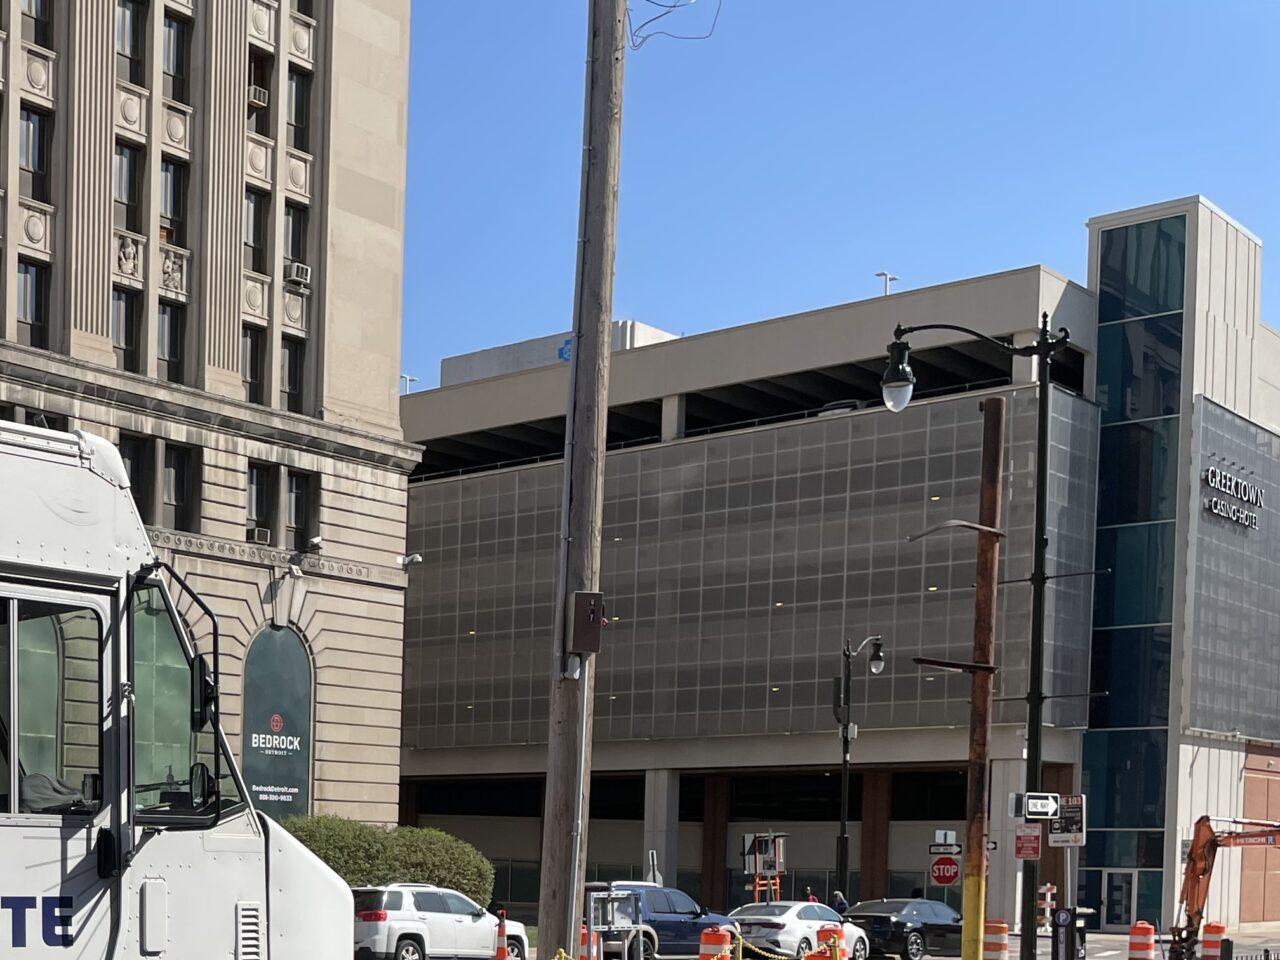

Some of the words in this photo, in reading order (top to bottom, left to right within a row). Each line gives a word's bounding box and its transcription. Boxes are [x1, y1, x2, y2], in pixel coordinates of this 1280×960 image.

[1208, 466, 1265, 507] GREEKTOWN
[252, 734, 300, 751] BEDROCK
[1029, 801, 1039, 810] ONE
[932, 864, 958, 877] STOP
